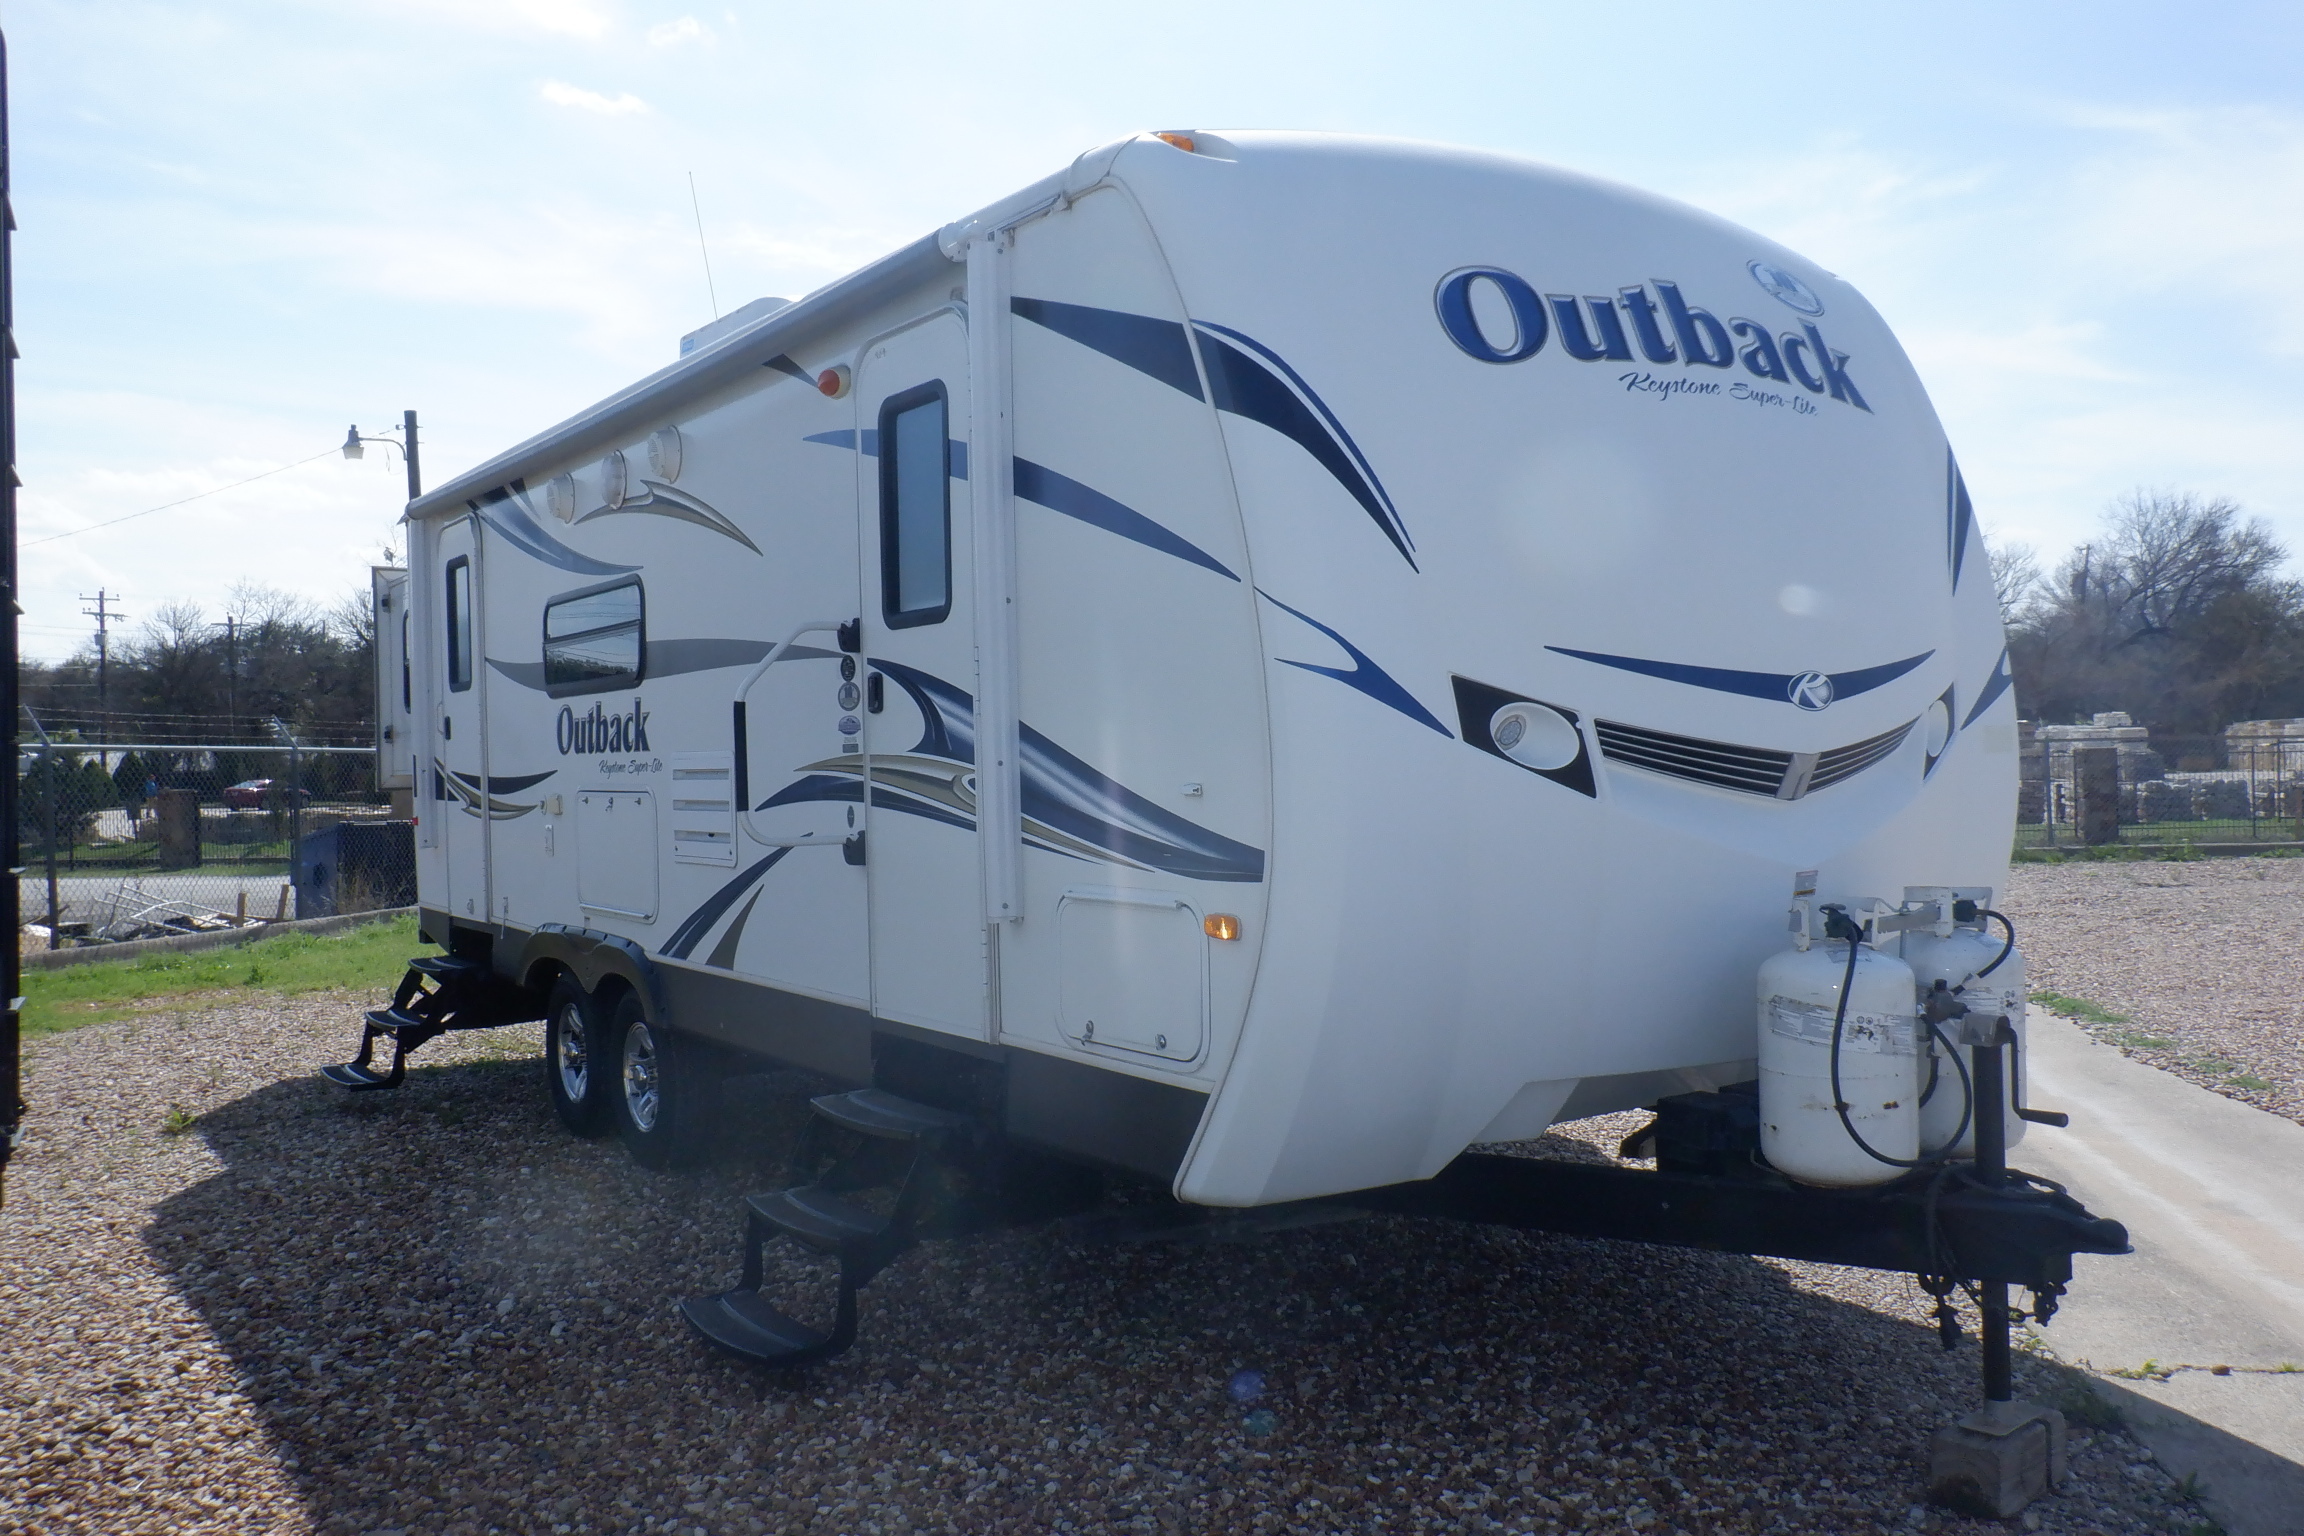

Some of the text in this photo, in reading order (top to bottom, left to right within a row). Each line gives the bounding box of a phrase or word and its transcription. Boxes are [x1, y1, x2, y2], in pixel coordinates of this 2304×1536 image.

[1433, 264, 1875, 415] Outback
[1618, 371, 1722, 401] Keystone
[557, 697, 651, 755] Outback
